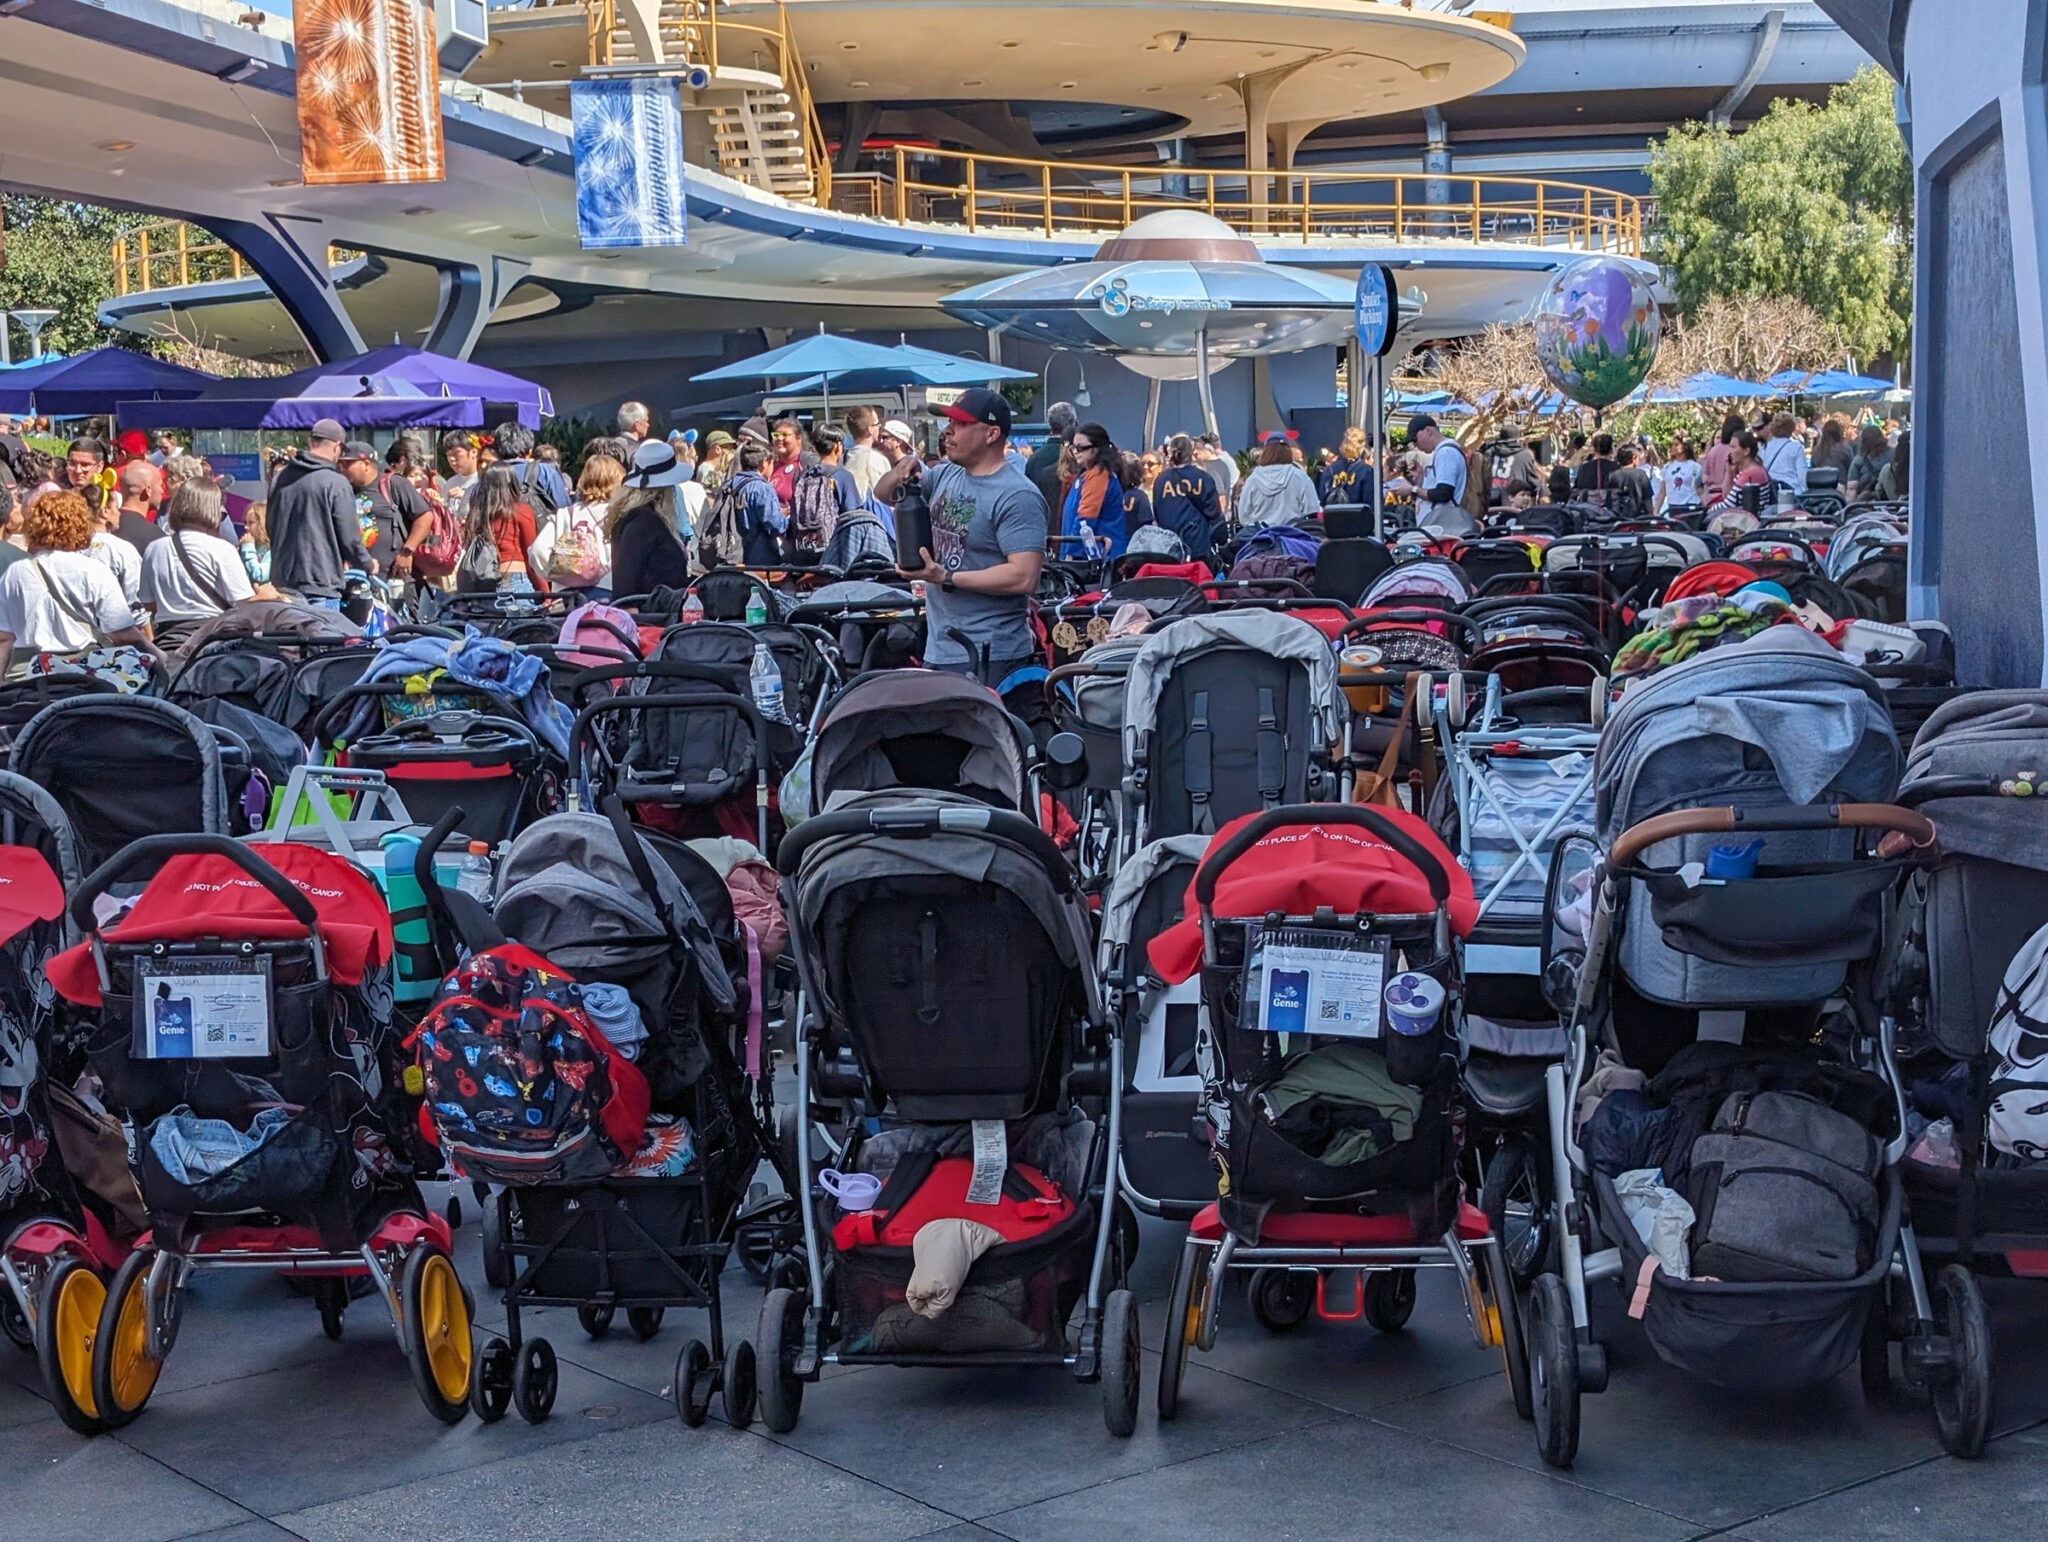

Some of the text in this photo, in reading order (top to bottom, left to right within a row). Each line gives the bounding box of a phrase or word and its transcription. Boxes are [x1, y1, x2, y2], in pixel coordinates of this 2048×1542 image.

[1130, 295, 1232, 316] Disney Vacation Club
[1361, 291, 1381, 307] Stroller
[1360, 308, 1383, 326] Parking
[1491, 455, 1515, 479] 13
[1162, 479, 1203, 499] AOJ
[1271, 835, 1297, 845] PLACE
[1330, 833, 1343, 841] ON
[1344, 835, 1361, 845] TOP
[193, 882, 211, 892] NOT
[300, 881, 311, 891] OF
[311, 887, 344, 898] CANOPY
[1273, 998, 1299, 1009] Genie
[160, 1025, 185, 1035] Genie
